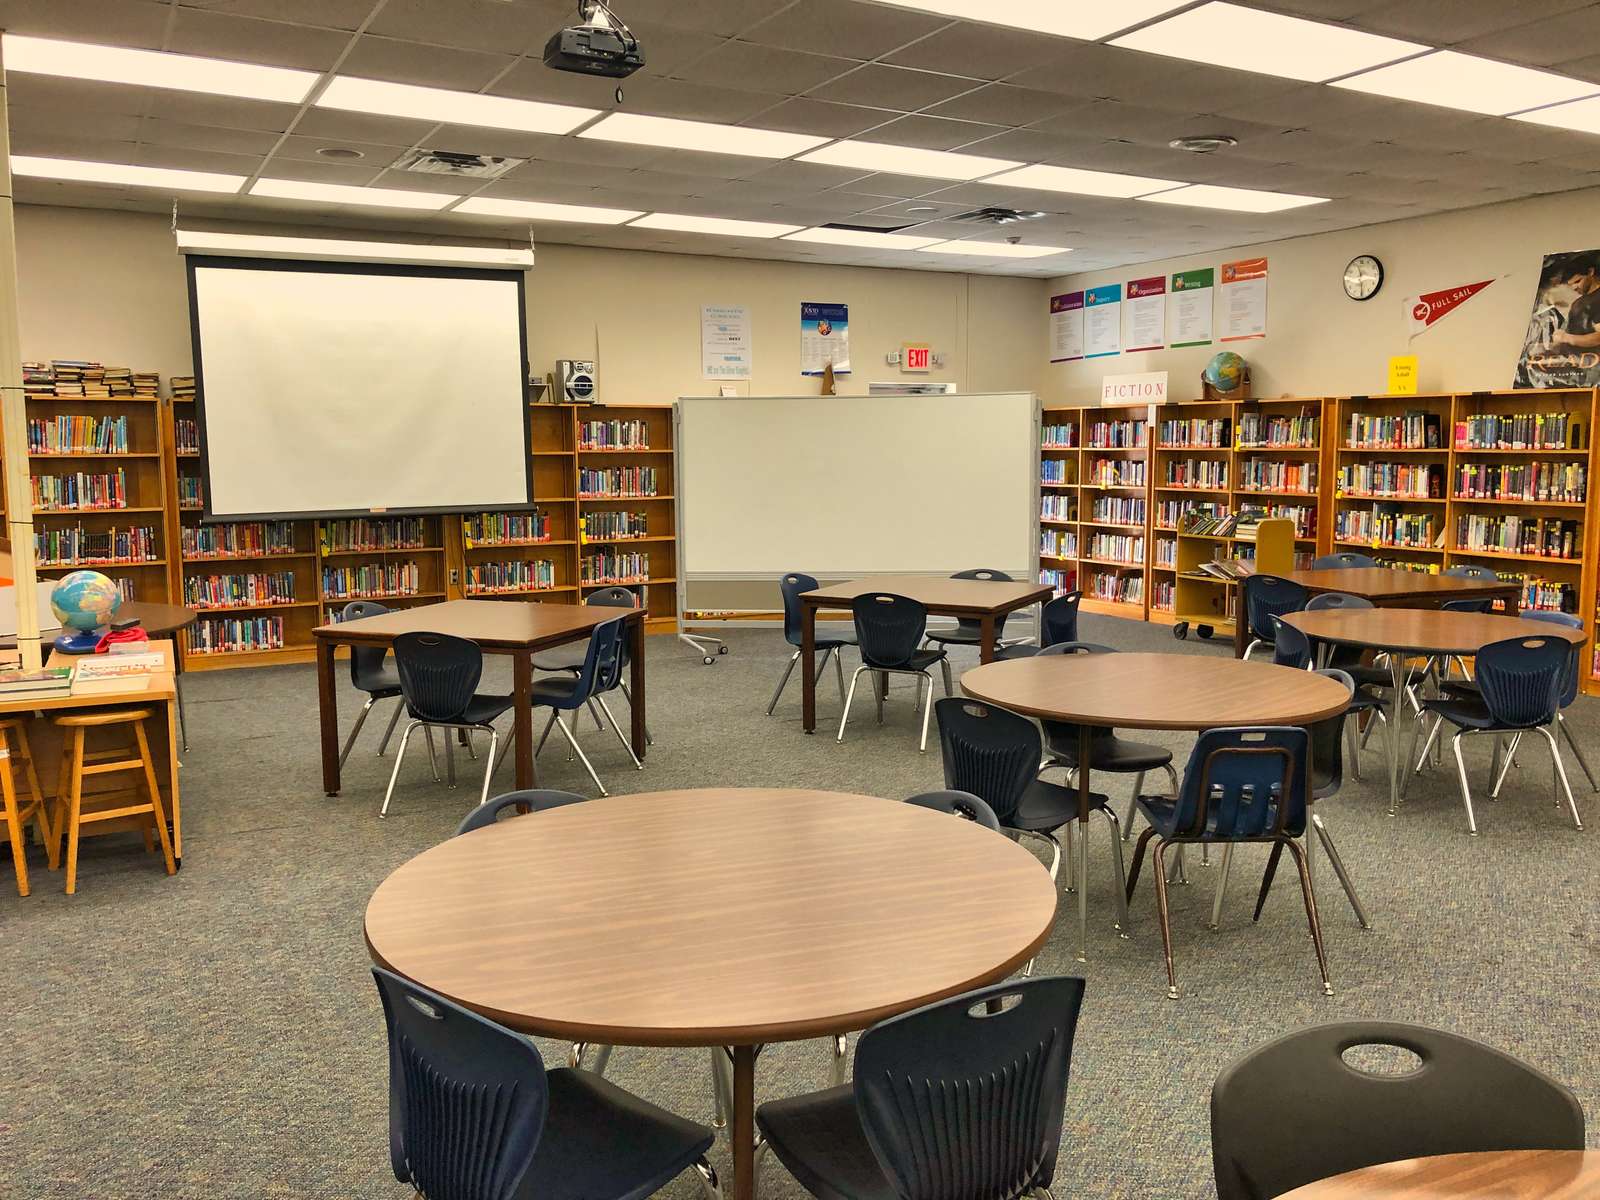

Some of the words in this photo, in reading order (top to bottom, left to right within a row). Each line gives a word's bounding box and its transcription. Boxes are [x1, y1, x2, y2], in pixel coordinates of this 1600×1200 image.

[1432, 297, 1451, 310] FULL
[1453, 287, 1472, 301] SAIL
[908, 349, 929, 368] EXIT
[1526, 352, 1600, 372] READ
[1105, 383, 1165, 399] FICTION
